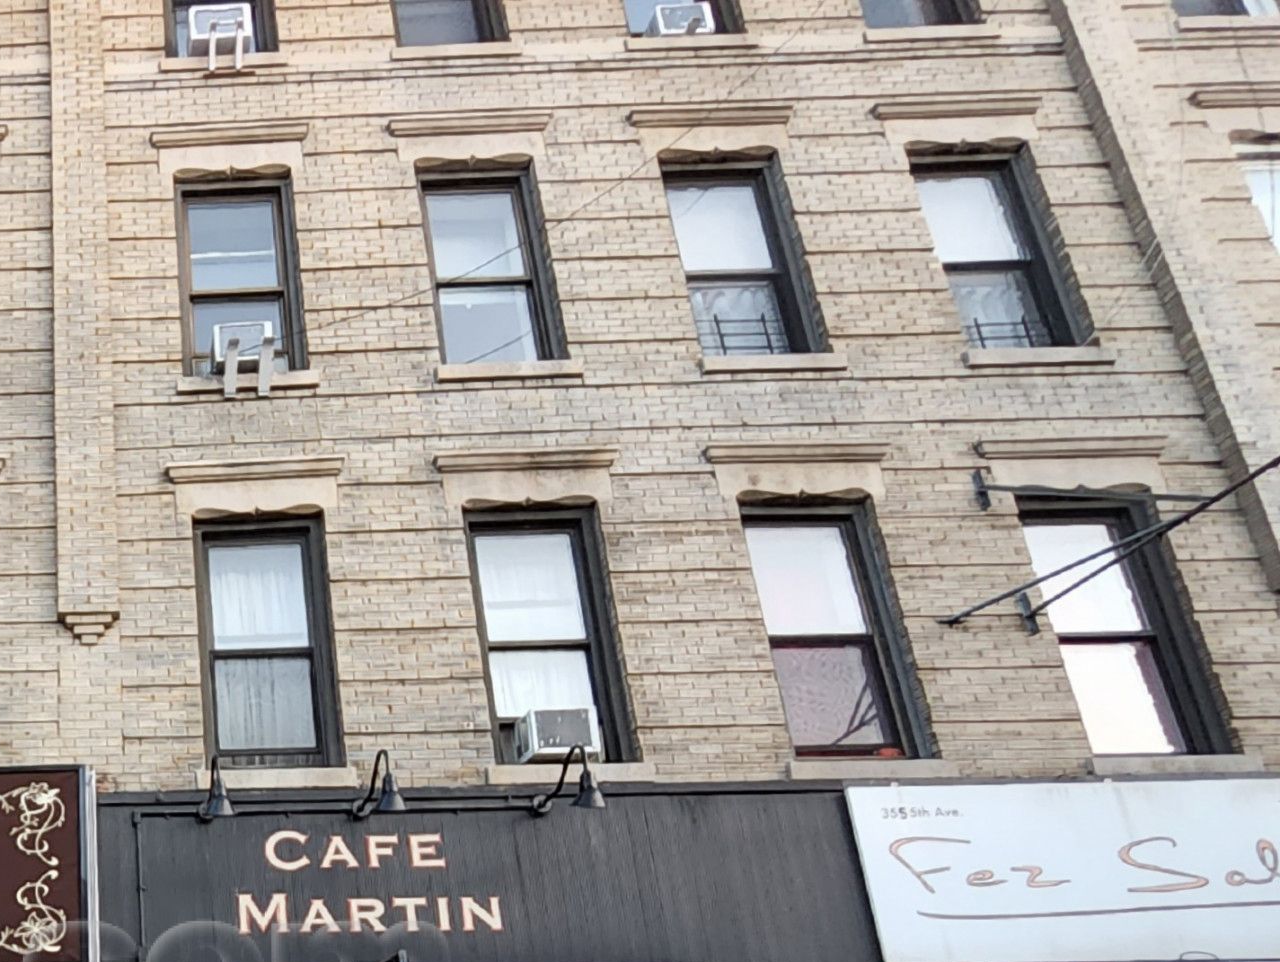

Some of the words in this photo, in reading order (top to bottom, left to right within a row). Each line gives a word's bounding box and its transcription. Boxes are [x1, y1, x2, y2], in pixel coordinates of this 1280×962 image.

[264, 830, 447, 871] CAFE
[889, 836, 1071, 895] Fez
[236, 892, 505, 935] MARTIN
